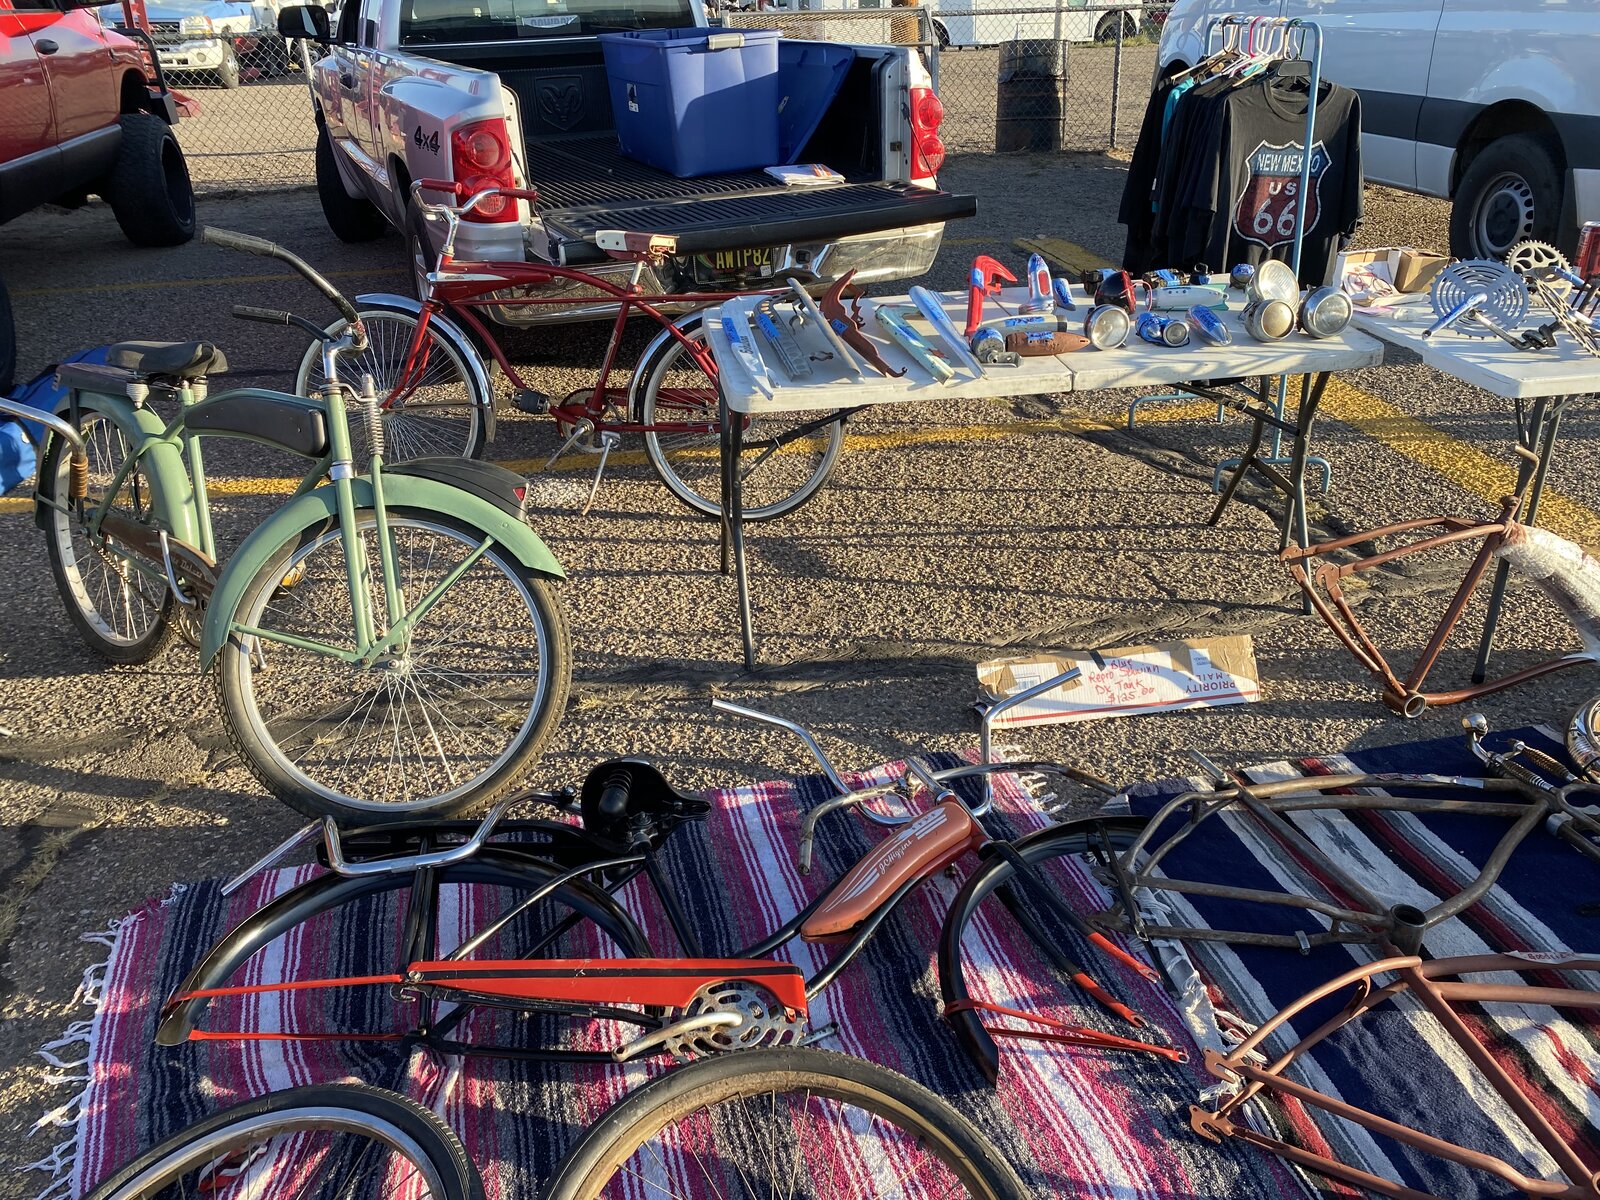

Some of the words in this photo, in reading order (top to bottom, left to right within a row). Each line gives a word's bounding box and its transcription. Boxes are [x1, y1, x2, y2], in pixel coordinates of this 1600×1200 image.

[1257, 154, 1281, 171] NEW
[1281, 154, 1320, 173] MEXO
[1253, 198, 1296, 236] 66
[1111, 659, 1133, 669] Blue
[1196, 672, 1223, 681] MAIL
[1115, 679, 1145, 690] Tank
[1186, 680, 1236, 693] PRIORITY
